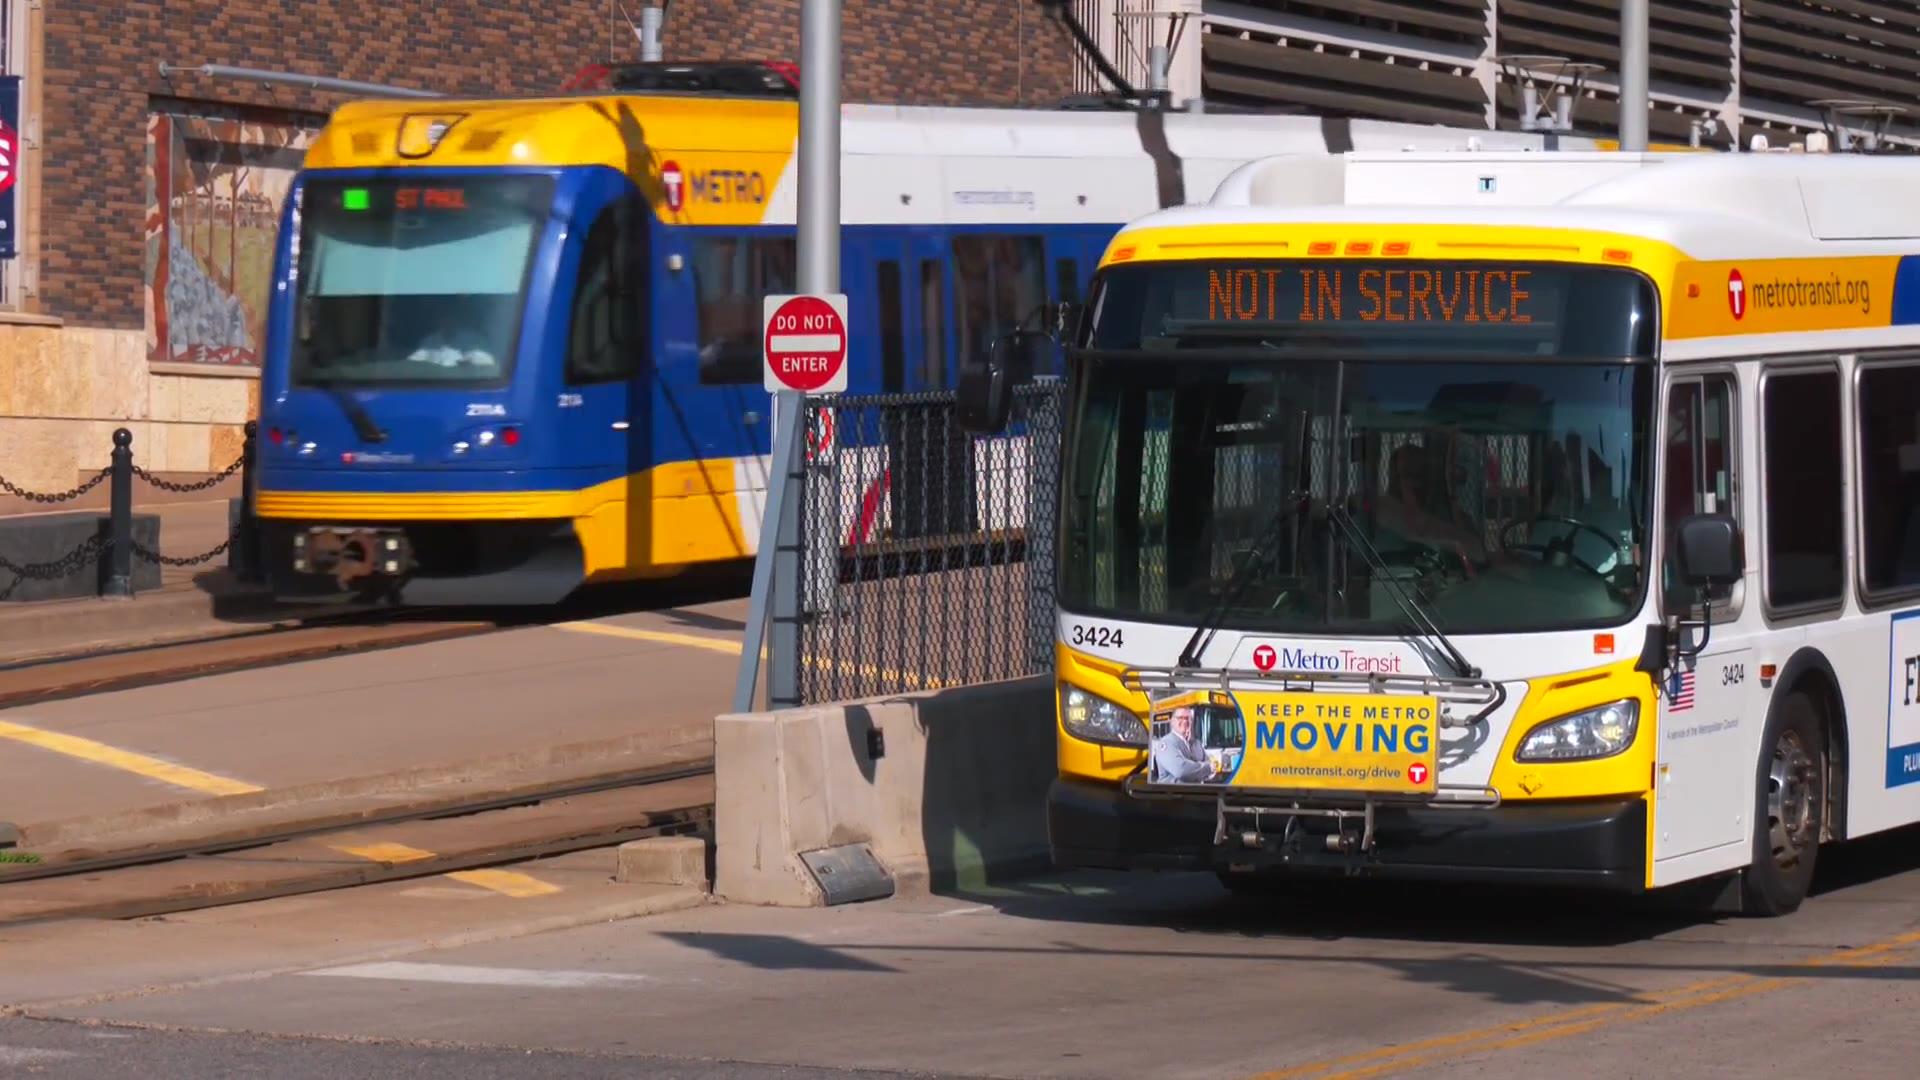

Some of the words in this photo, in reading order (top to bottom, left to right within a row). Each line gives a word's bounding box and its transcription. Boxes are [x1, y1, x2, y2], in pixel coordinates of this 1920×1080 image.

[690, 169, 765, 203] METRO
[1208, 269, 1282, 321] NOT
[1299, 270, 1343, 321] IN
[1358, 270, 1532, 323] SERVICE
[1752, 271, 1871, 315] metrotransit.org
[777, 315, 797, 330] DO
[803, 314, 834, 330] NOT
[782, 356, 828, 373] ENTER
[1072, 624, 1124, 649] 3424
[1722, 663, 1744, 687] 3424
[1256, 703, 1306, 717] KEEP
[1317, 705, 1352, 718] THE
[1363, 706, 1431, 720] METRO
[1255, 720, 1430, 753] MOVING
[1270, 765, 1401, 780] metrotransit.org/drive
